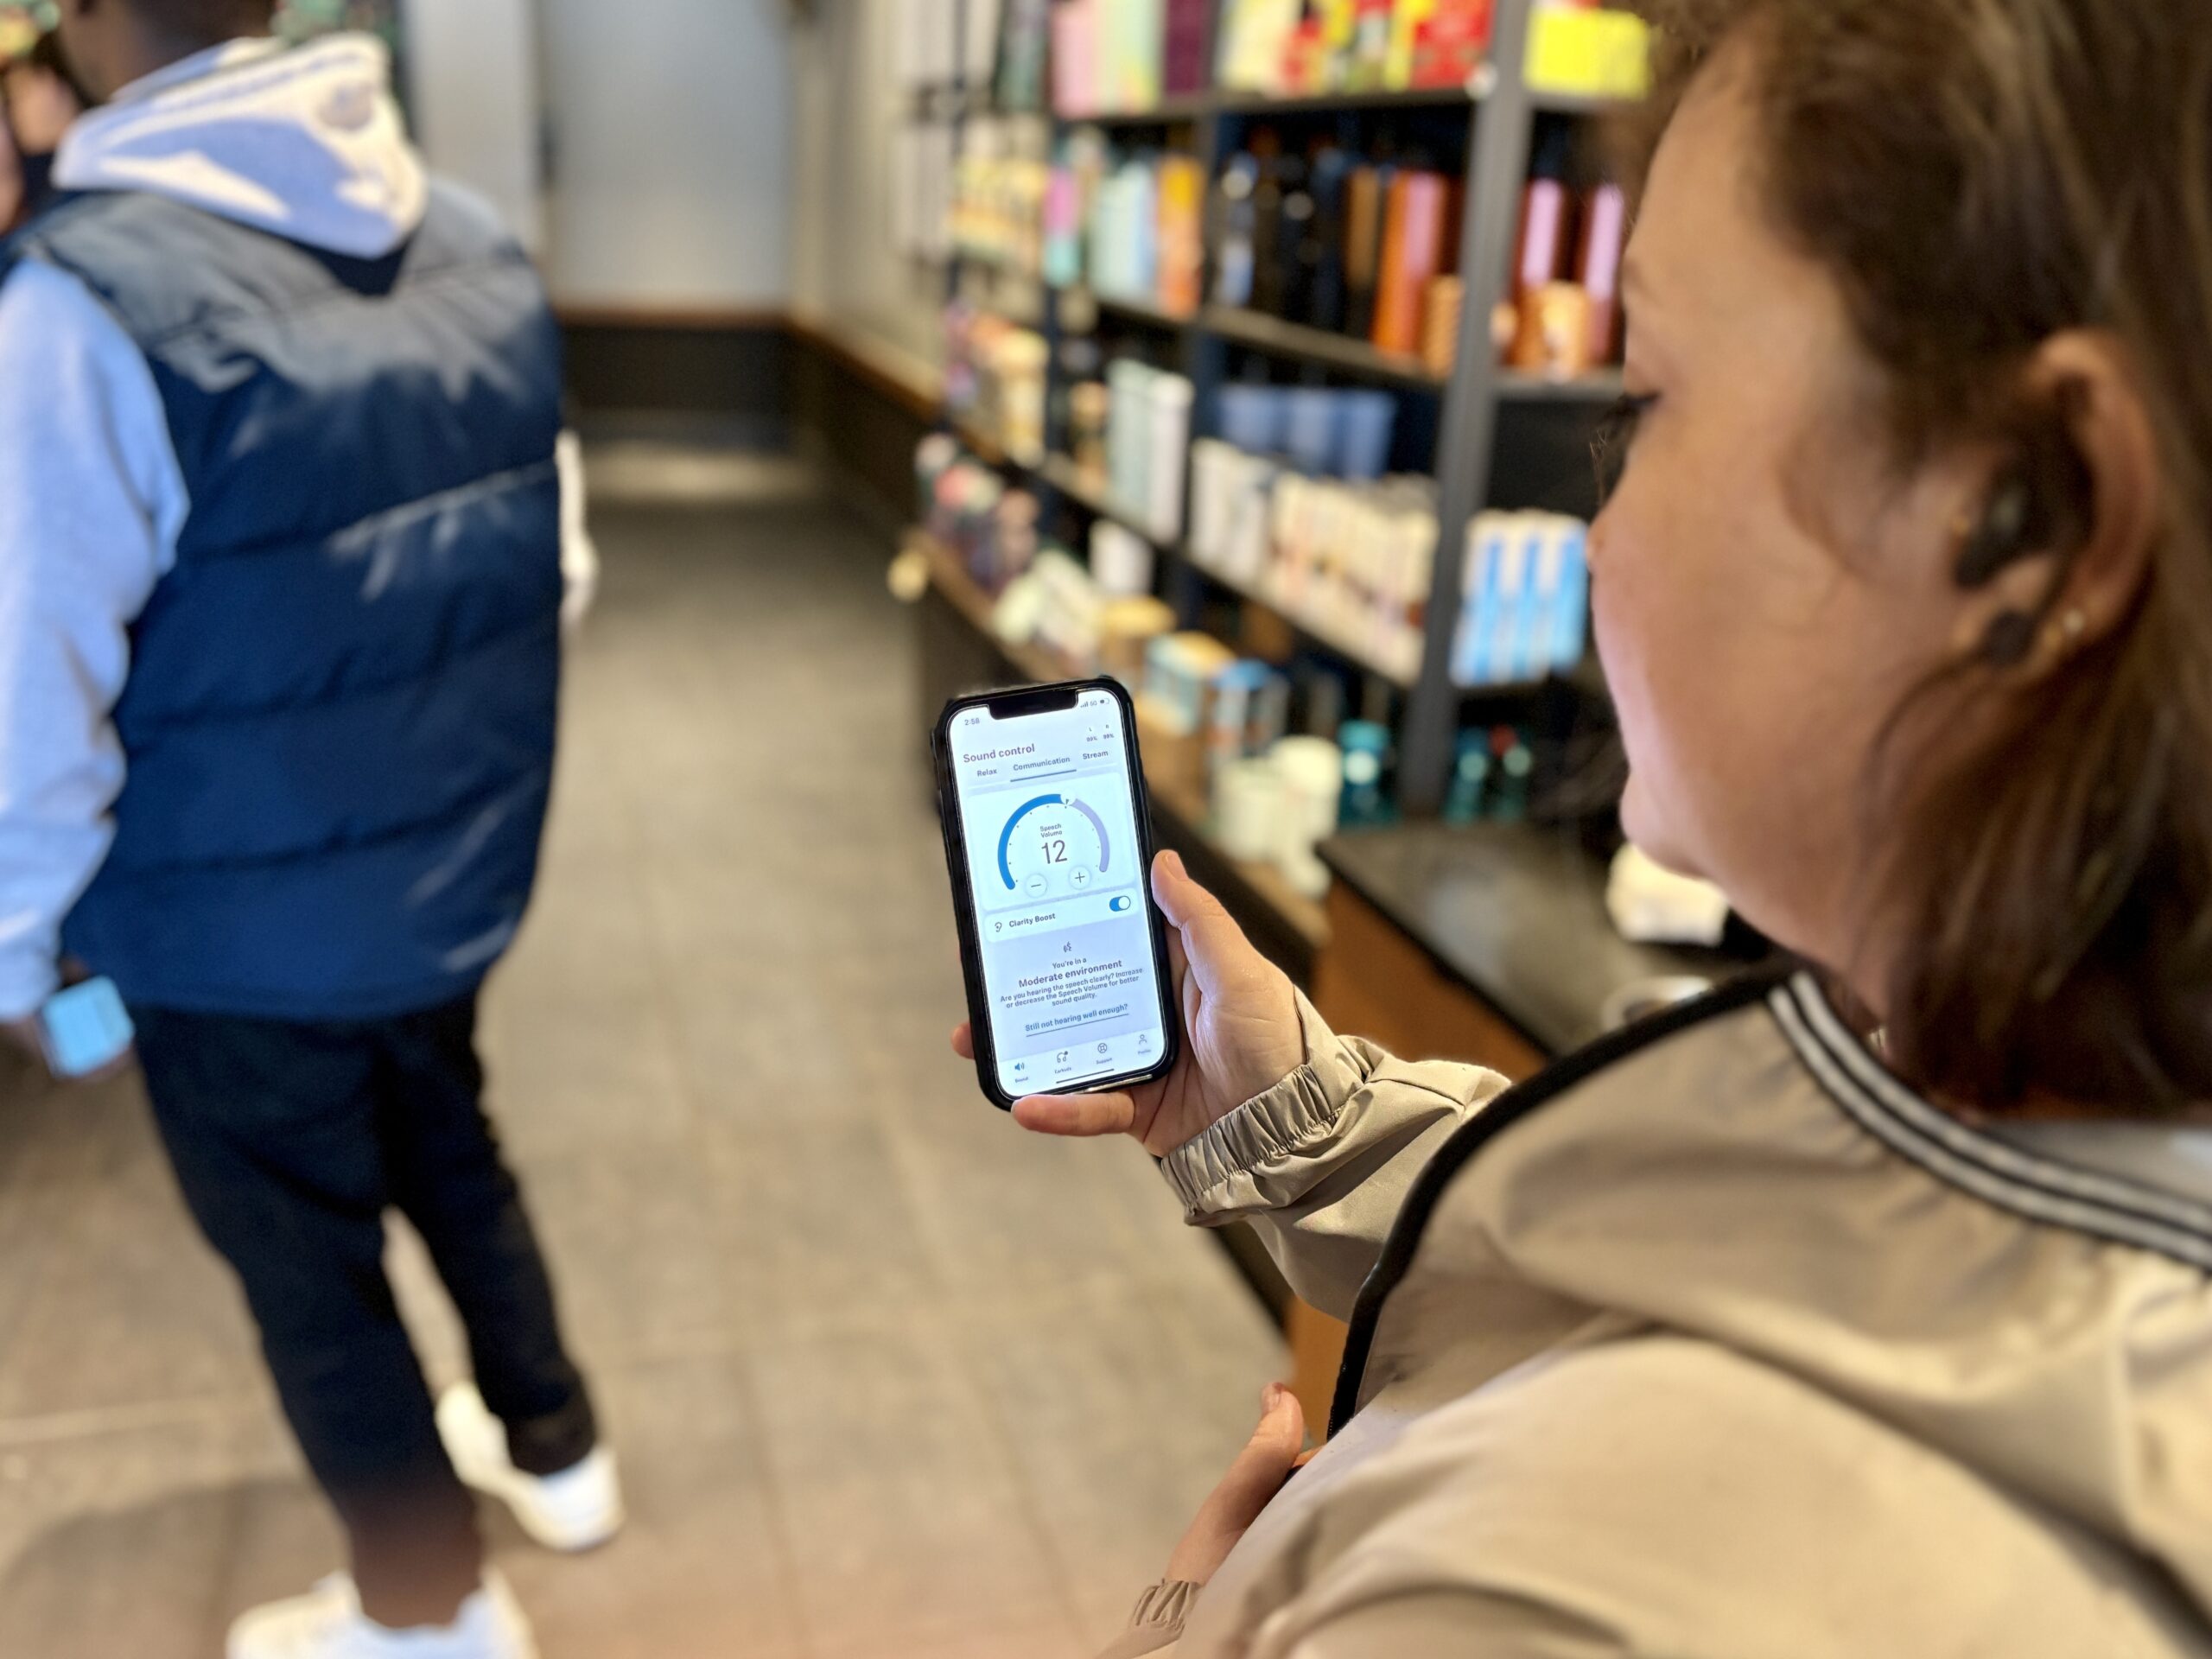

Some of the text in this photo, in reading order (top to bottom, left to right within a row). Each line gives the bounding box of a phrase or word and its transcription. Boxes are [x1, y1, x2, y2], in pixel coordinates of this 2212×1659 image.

[963, 743, 1035, 763] Sound control
[1083, 751, 1109, 760] Stream
[1013, 756, 1071, 771] Communication
[977, 768, 997, 777] Relax
[1040, 823, 1062, 832] Speech
[1041, 839, 1068, 864] 12
[1009, 913, 1056, 928] Clarity Boost
[1052, 960, 1074, 969] You're
[1019, 960, 1123, 988] Moderate environment
[1013, 993, 1026, 1001] you
[1027, 987, 1052, 997] hearing
[1065, 979, 1089, 989] speech
[1090, 973, 1114, 984] clearly?
[1116, 968, 1143, 977] Increase
[1014, 995, 1045, 1007] decrease
[1058, 988, 1083, 999] Speech
[1084, 982, 1108, 993] Volume
[1120, 976, 1139, 985] better
[1052, 993, 1097, 1007] sound quality.
[1026, 1003, 1128, 1032] Still not hearing well enough?
